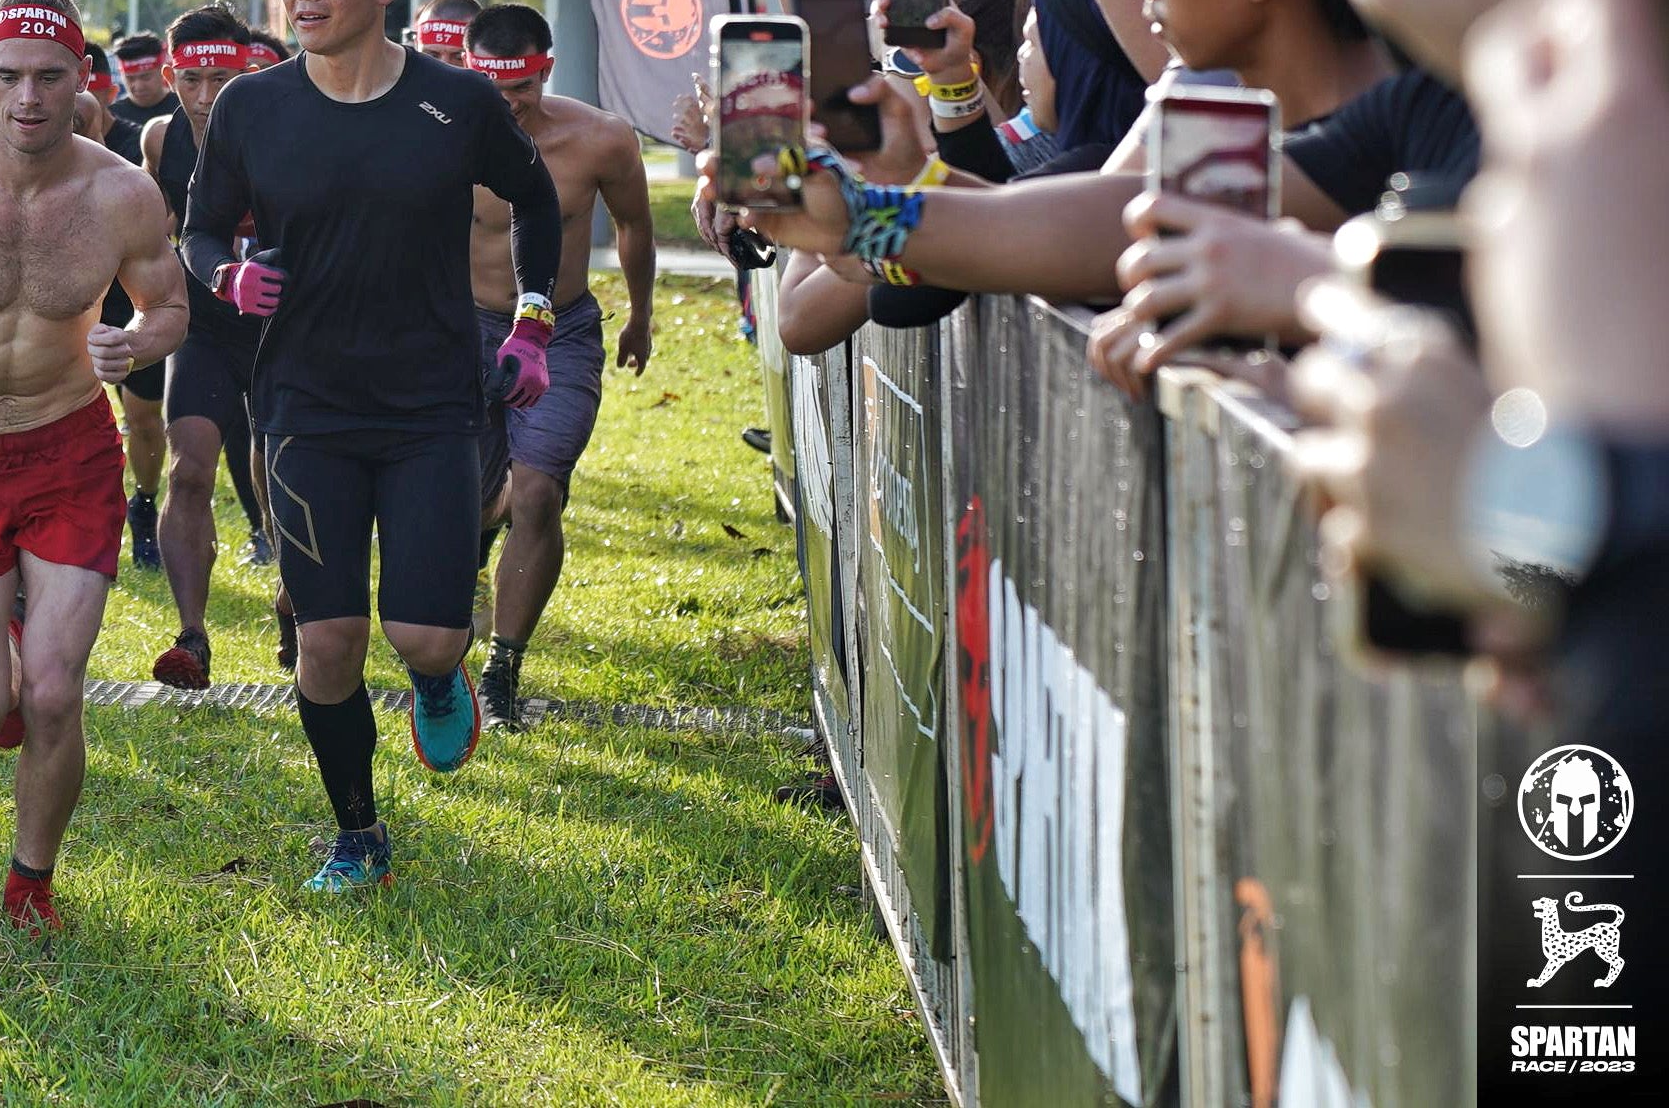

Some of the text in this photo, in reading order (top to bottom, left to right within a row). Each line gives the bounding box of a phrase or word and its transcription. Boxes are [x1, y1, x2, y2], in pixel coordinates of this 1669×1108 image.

[8, 7, 67, 29] SPARTAN
[20, 22, 56, 38] 204
[432, 23, 467, 34] SPART
[435, 33, 452, 43] 57
[196, 45, 237, 56] SPARTAN
[200, 57, 215, 66] 91
[478, 58, 526, 70] SPARTAN
[418, 101, 452, 125] 2XU
